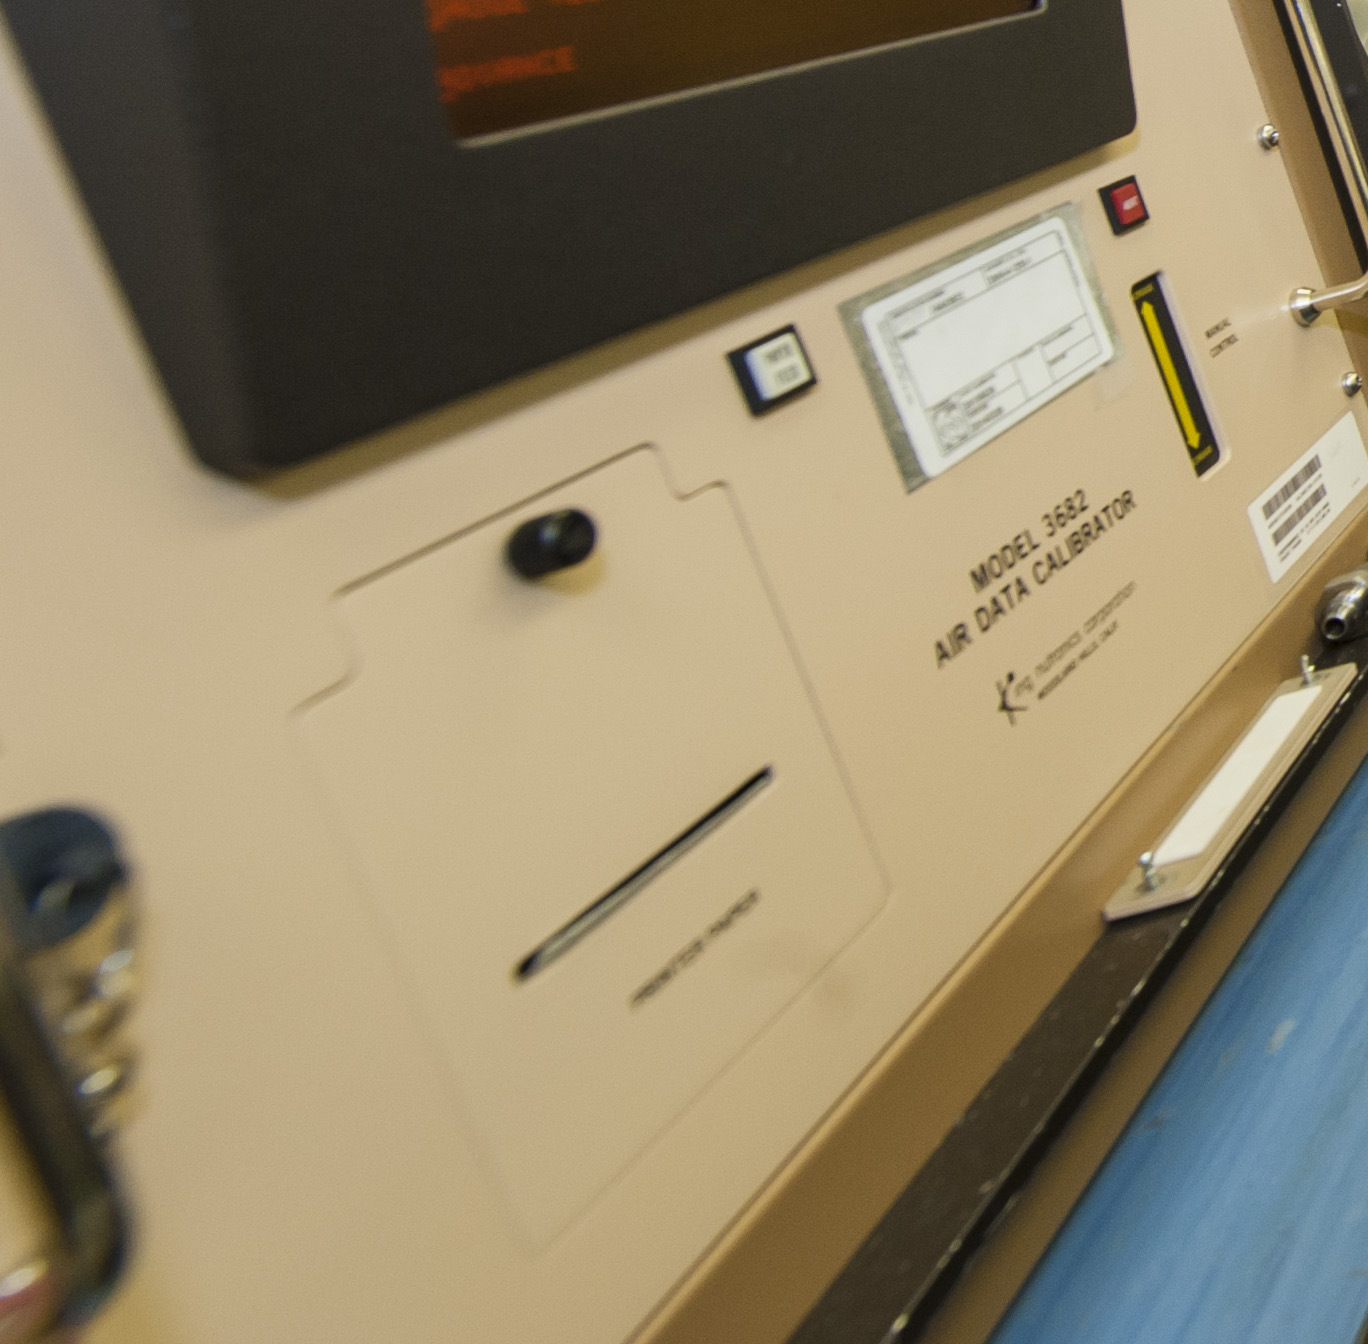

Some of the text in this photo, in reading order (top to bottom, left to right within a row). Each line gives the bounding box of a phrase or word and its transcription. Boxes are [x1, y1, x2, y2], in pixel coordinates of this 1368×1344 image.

[934, 489, 1138, 670] AIR DATA CALIBRATOR
[968, 488, 1089, 594] MODEL 3682
